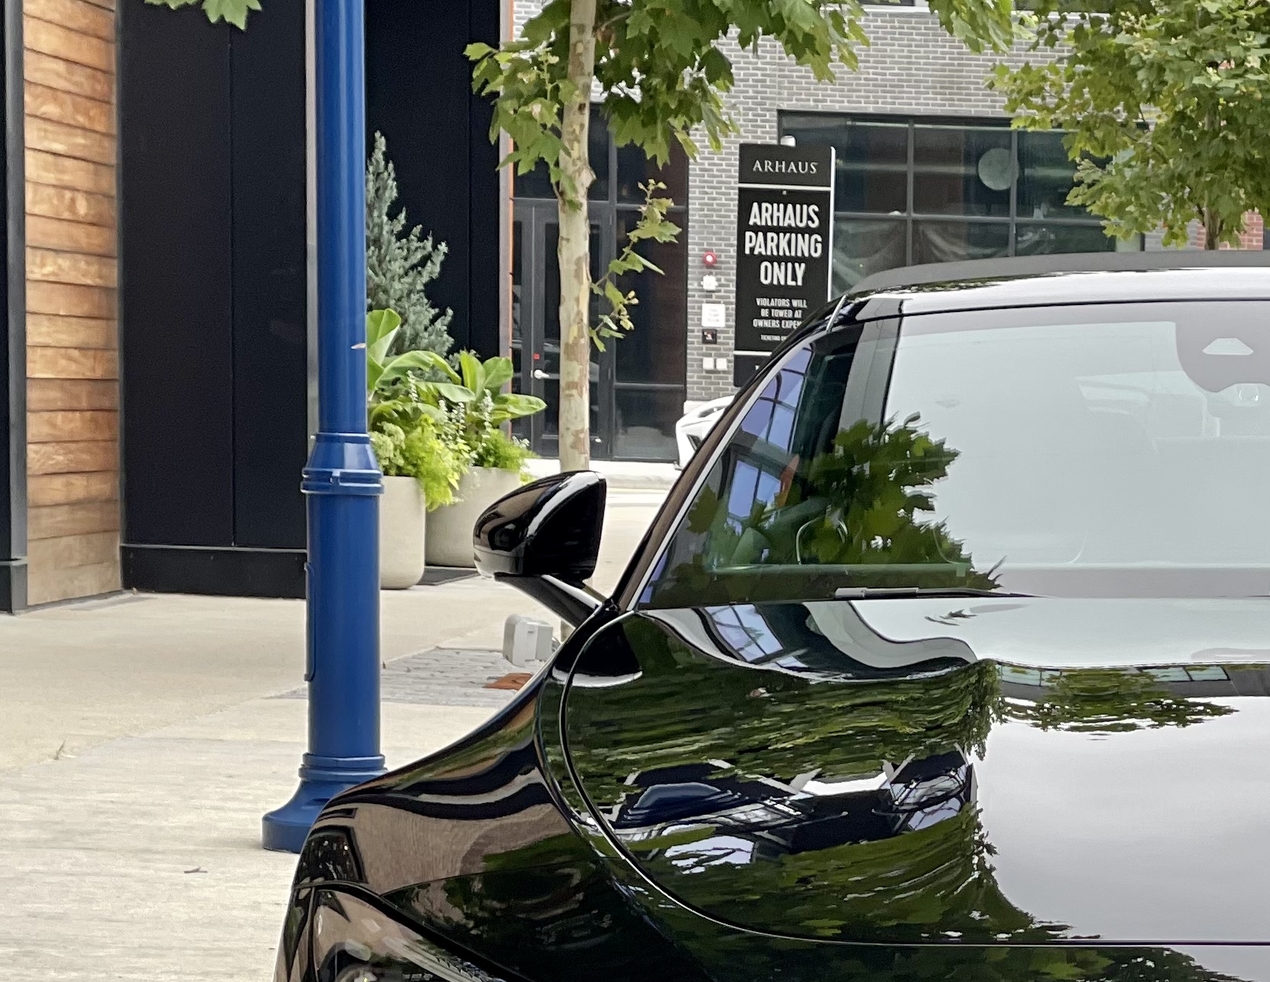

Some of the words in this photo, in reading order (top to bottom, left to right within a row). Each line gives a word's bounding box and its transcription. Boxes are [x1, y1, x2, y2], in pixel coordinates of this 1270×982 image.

[752, 159, 818, 174] ARHAUS
[749, 202, 820, 228] ARHAUS
[744, 231, 823, 258] PARKING
[759, 261, 806, 287] ONLY
[755, 297, 790, 307] VIOLATORS
[791, 299, 808, 308] WILL
[760, 308, 769, 317] BE
[771, 309, 793, 318] TOWED
[794, 310, 802, 318] AT
[752, 318, 780, 328] OWNERS
